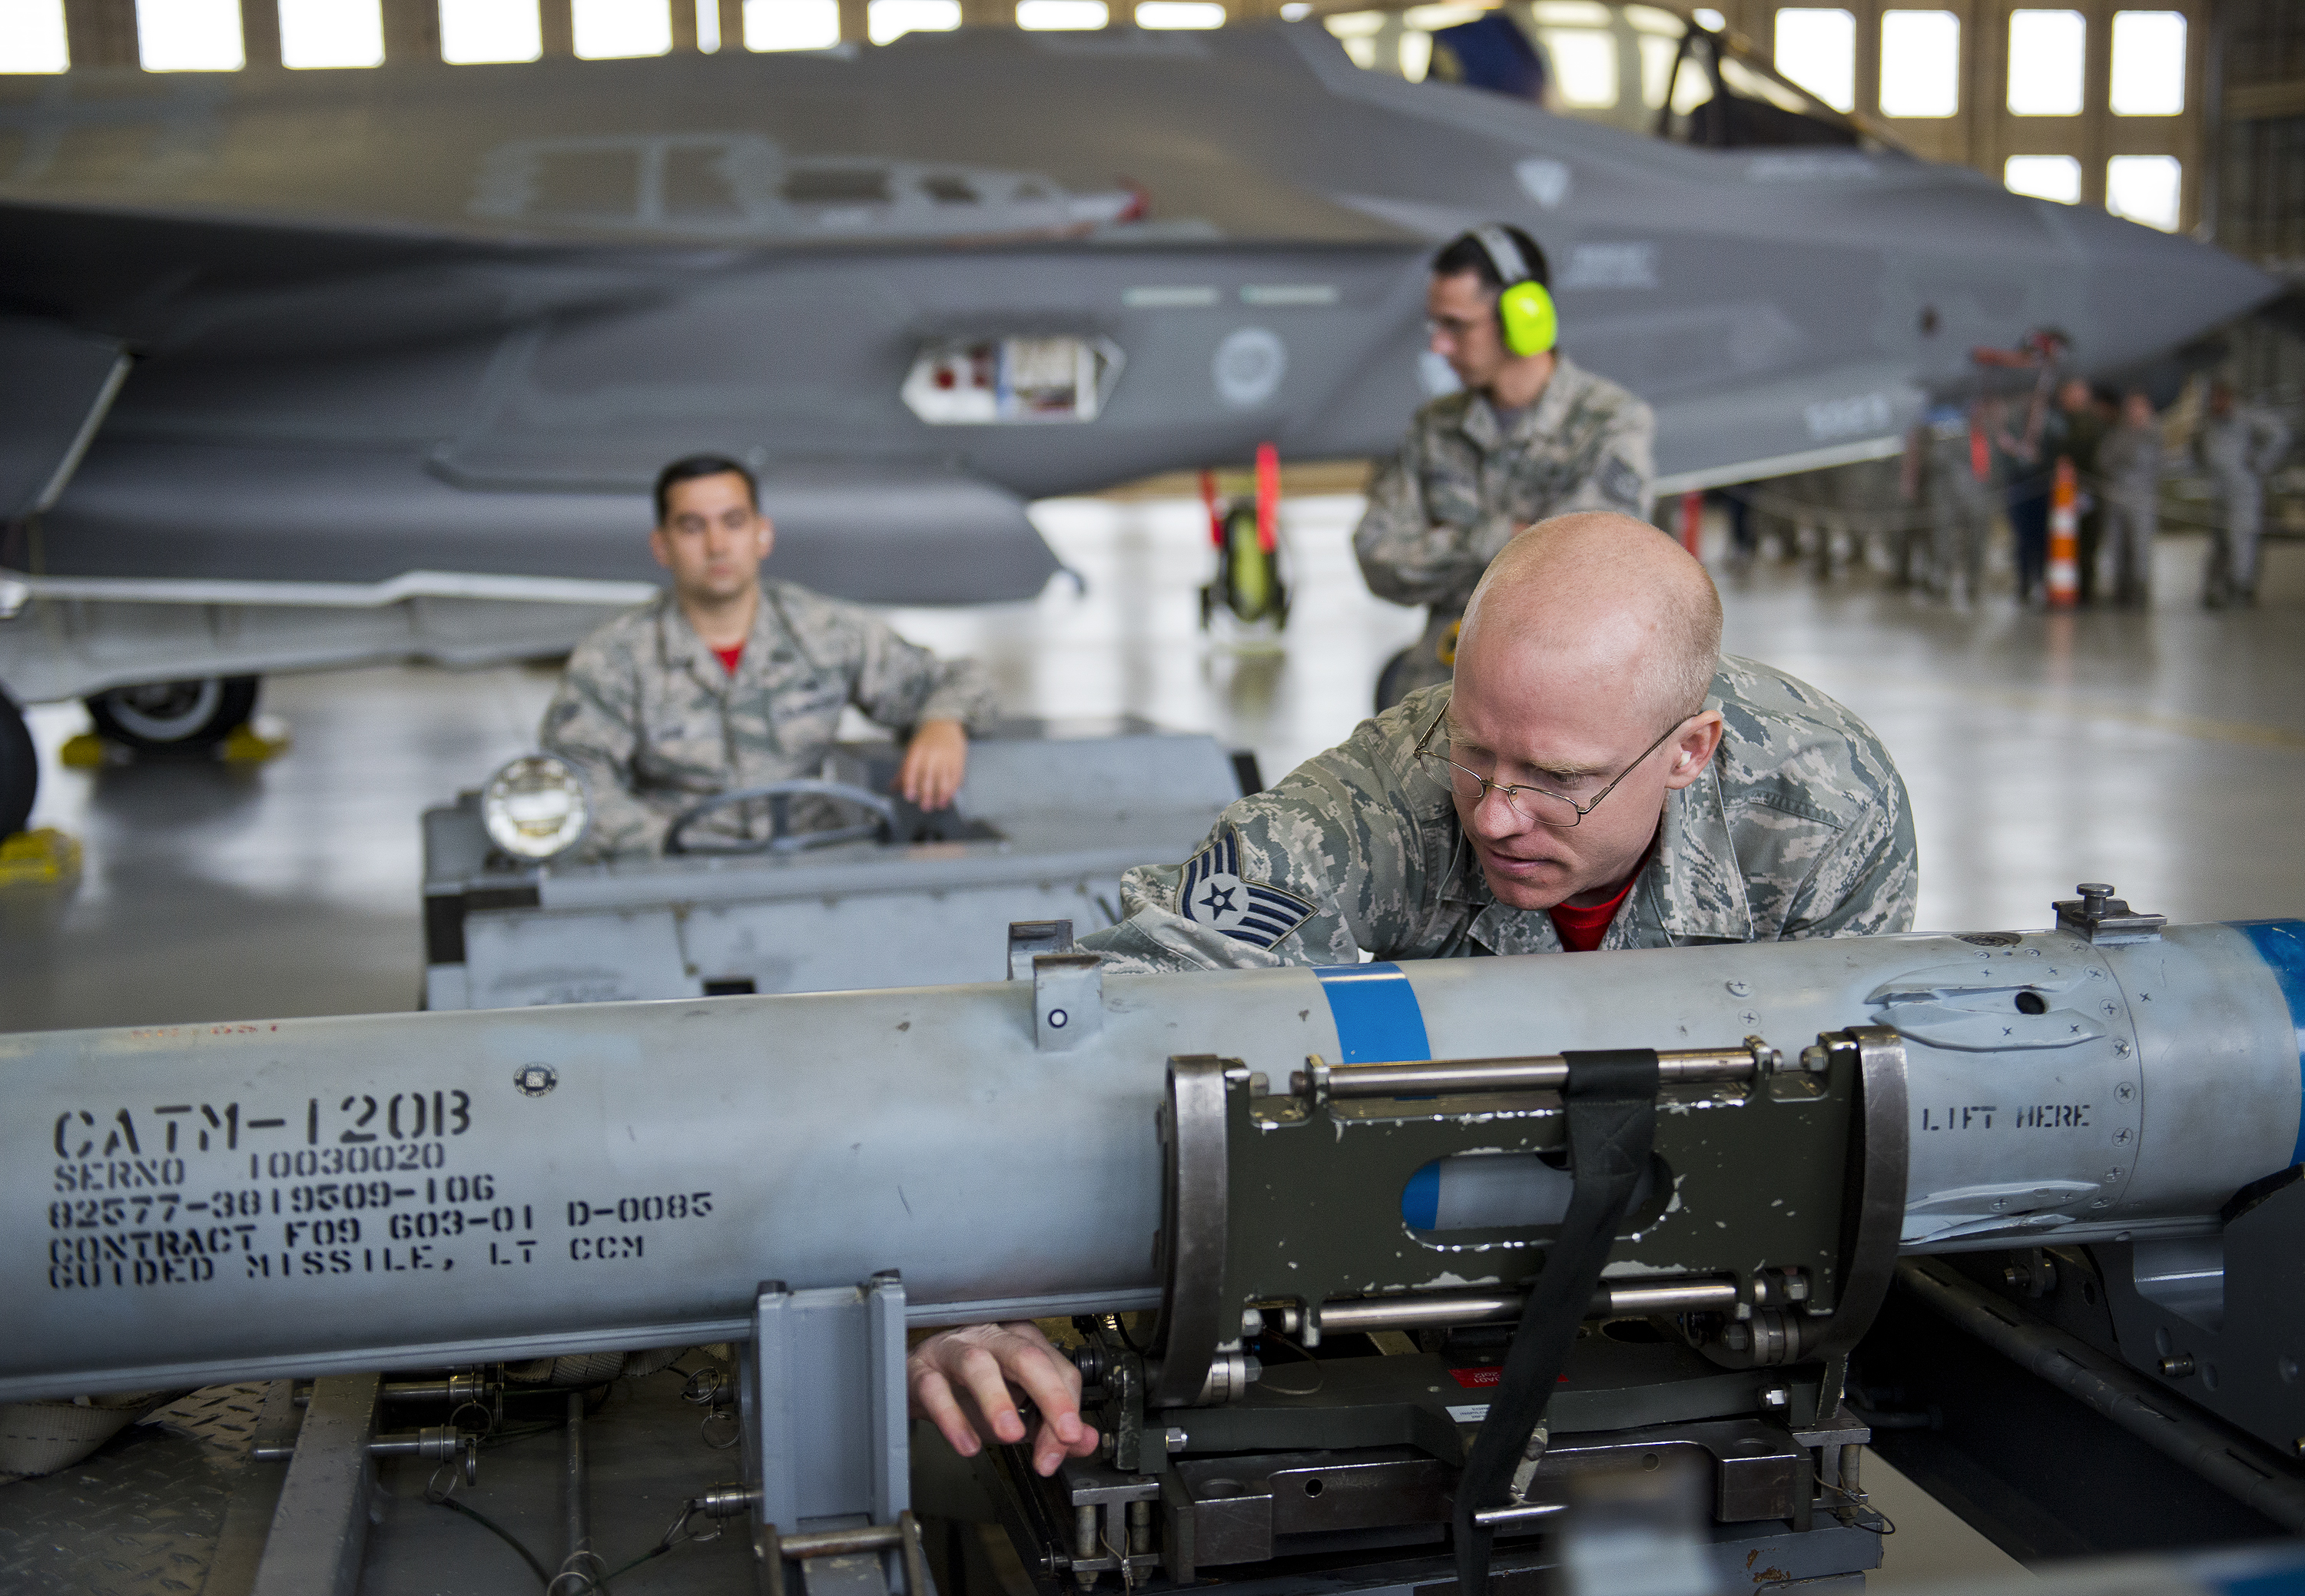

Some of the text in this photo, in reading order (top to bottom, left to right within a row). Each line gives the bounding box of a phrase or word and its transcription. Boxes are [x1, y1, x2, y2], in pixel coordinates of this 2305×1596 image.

[54, 1089, 471, 1159] CATM-120B
[1922, 1104, 2091, 1130] LIFT HERE
[54, 1142, 446, 1192] SERNO 10030020
[48, 1224, 257, 1264] CONTRACT
[567, 1192, 713, 1227] D-0085
[48, 1256, 214, 1289] GUIDED
[247, 1246, 454, 1277] MISSILE,
[490, 1239, 537, 1266] LT
